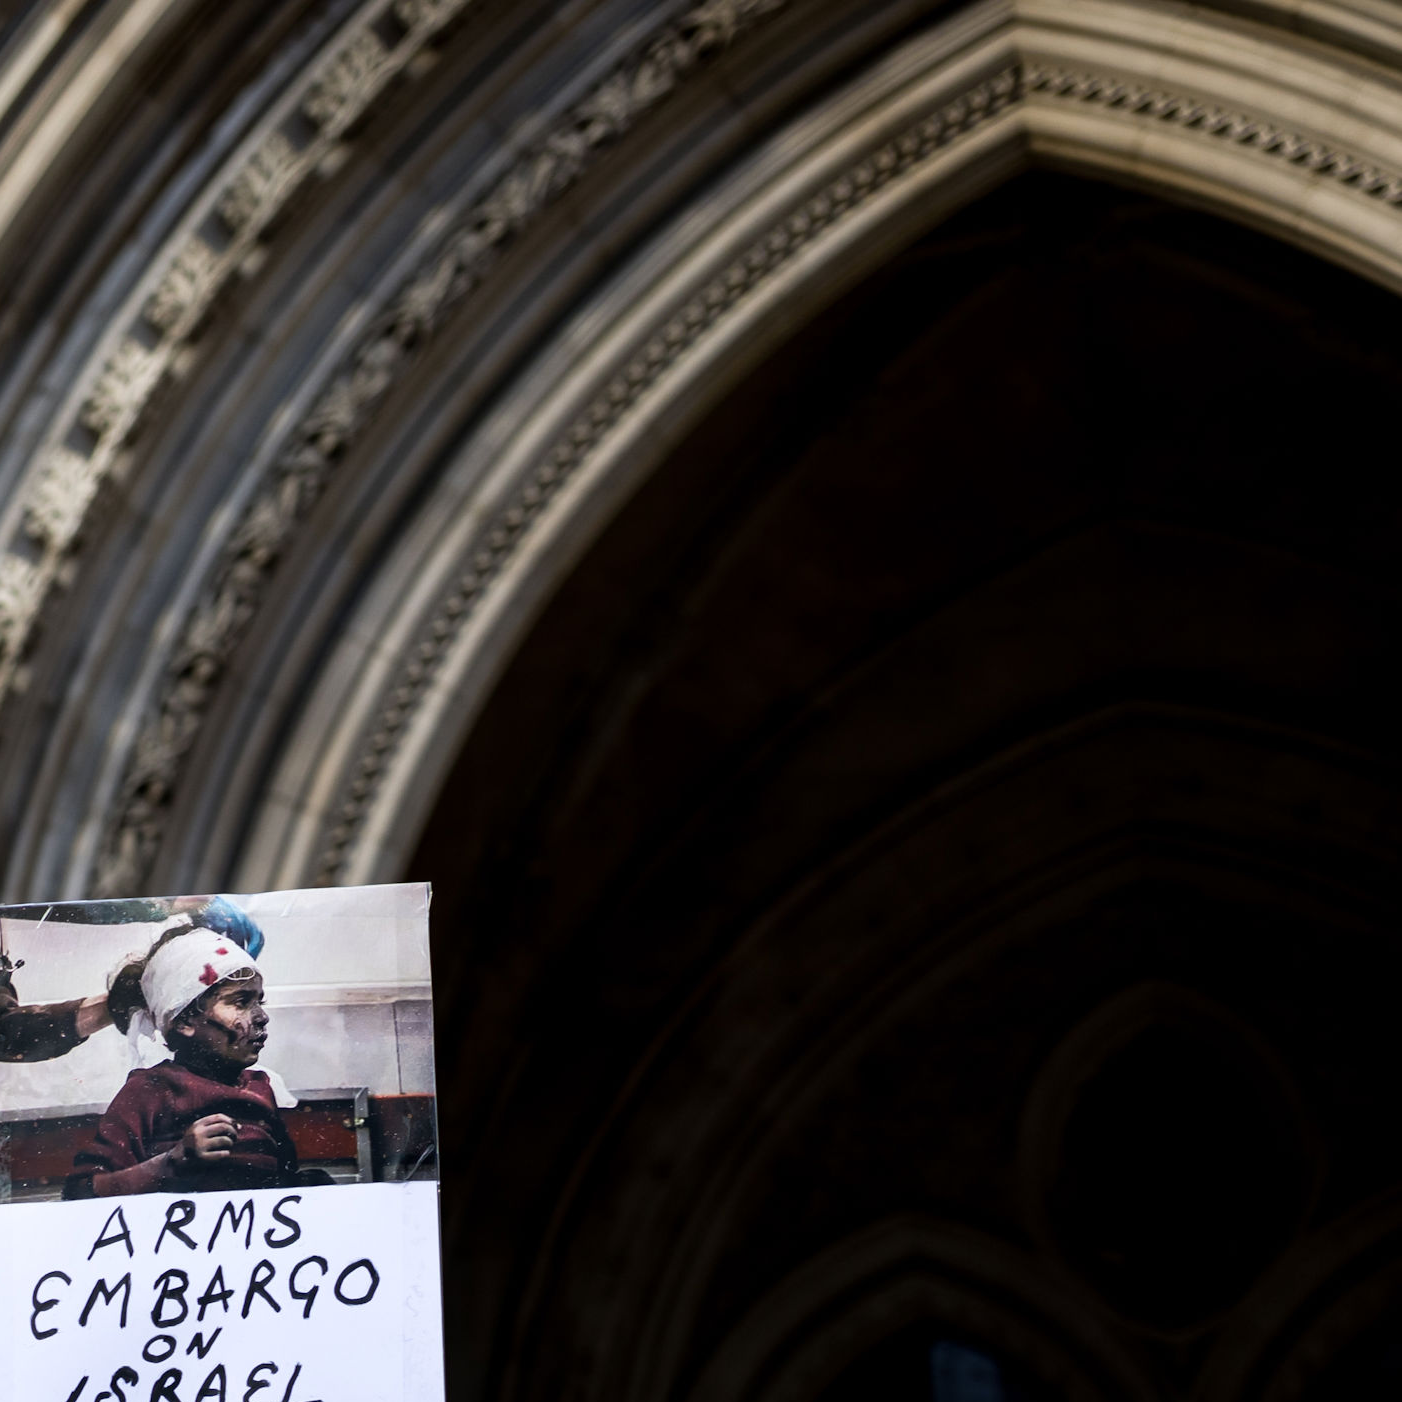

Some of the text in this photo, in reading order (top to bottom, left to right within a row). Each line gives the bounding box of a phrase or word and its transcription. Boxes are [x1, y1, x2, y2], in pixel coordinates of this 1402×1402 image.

[87, 1194, 303, 1262] ARMS
[29, 1255, 380, 1341] EMBARGO
[141, 1327, 223, 1364] ON
